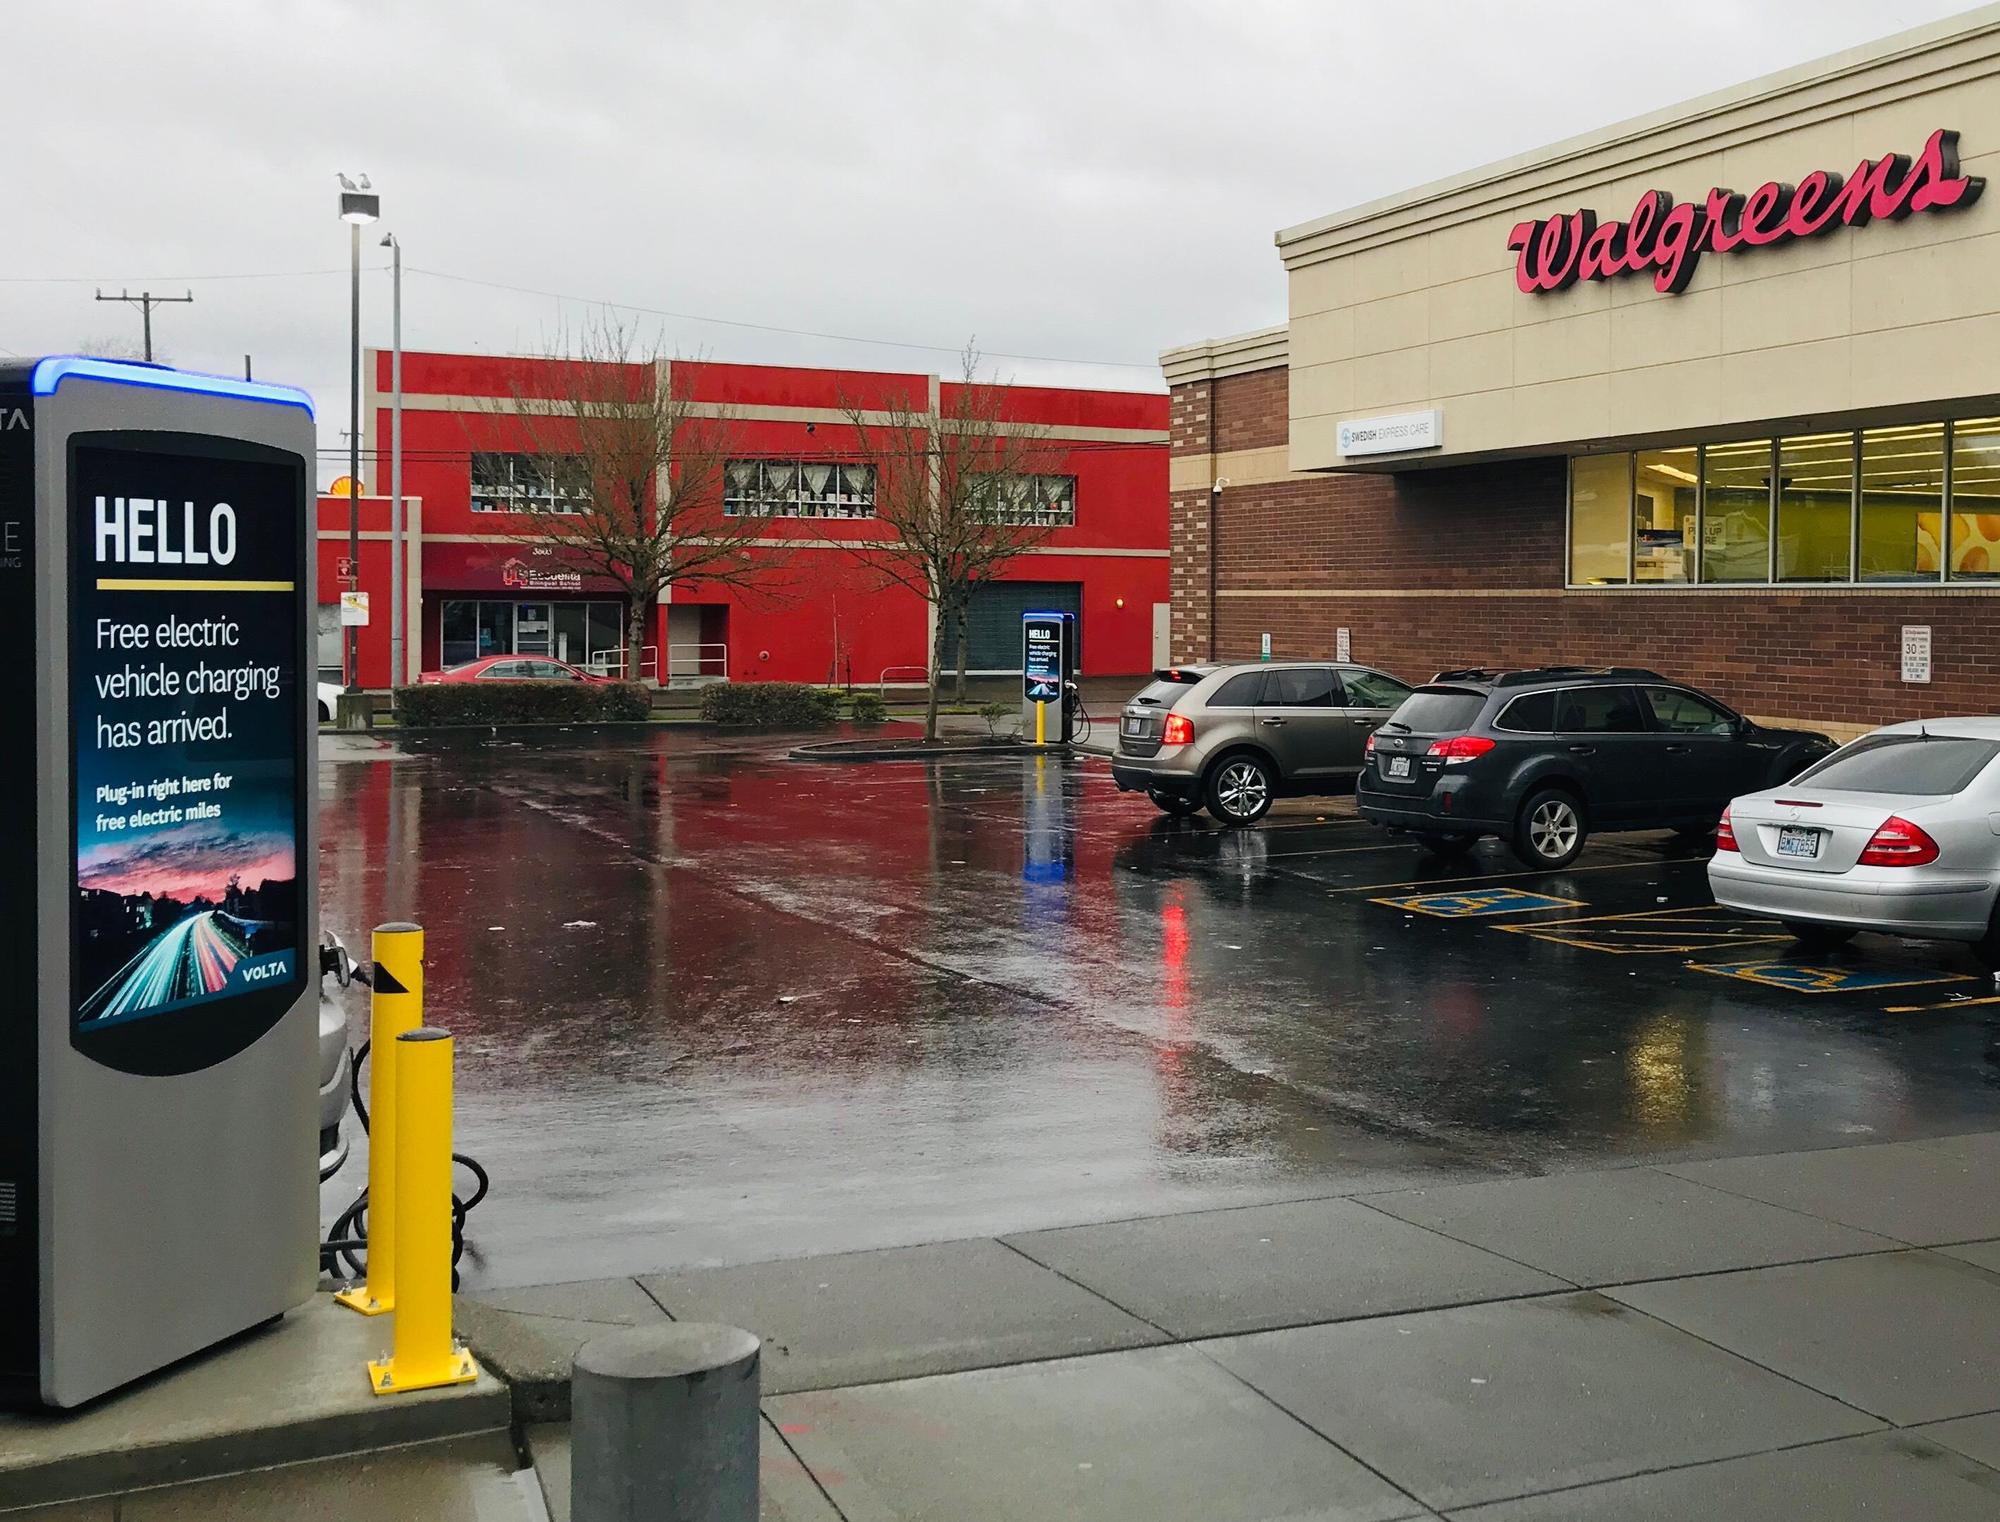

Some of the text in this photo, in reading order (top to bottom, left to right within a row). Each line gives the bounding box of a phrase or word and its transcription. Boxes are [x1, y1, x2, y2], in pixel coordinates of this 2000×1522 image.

[1508, 128, 1982, 293] Walgreens
[1351, 423, 1429, 442] SWEDISH EXPRESS CARE
[95, 496, 236, 565] HELLO
[1709, 527, 1722, 536] UP
[97, 614, 239, 649] Free electric
[1029, 629, 1050, 639] HELLO
[1905, 643, 1917, 655] 30
[95, 661, 280, 699] vehicle charging
[97, 707, 233, 748] has arrived.
[96, 772, 232, 805] Plug-in right here for
[96, 801, 221, 832] free electric miles
[242, 959, 287, 982] VOLTA
